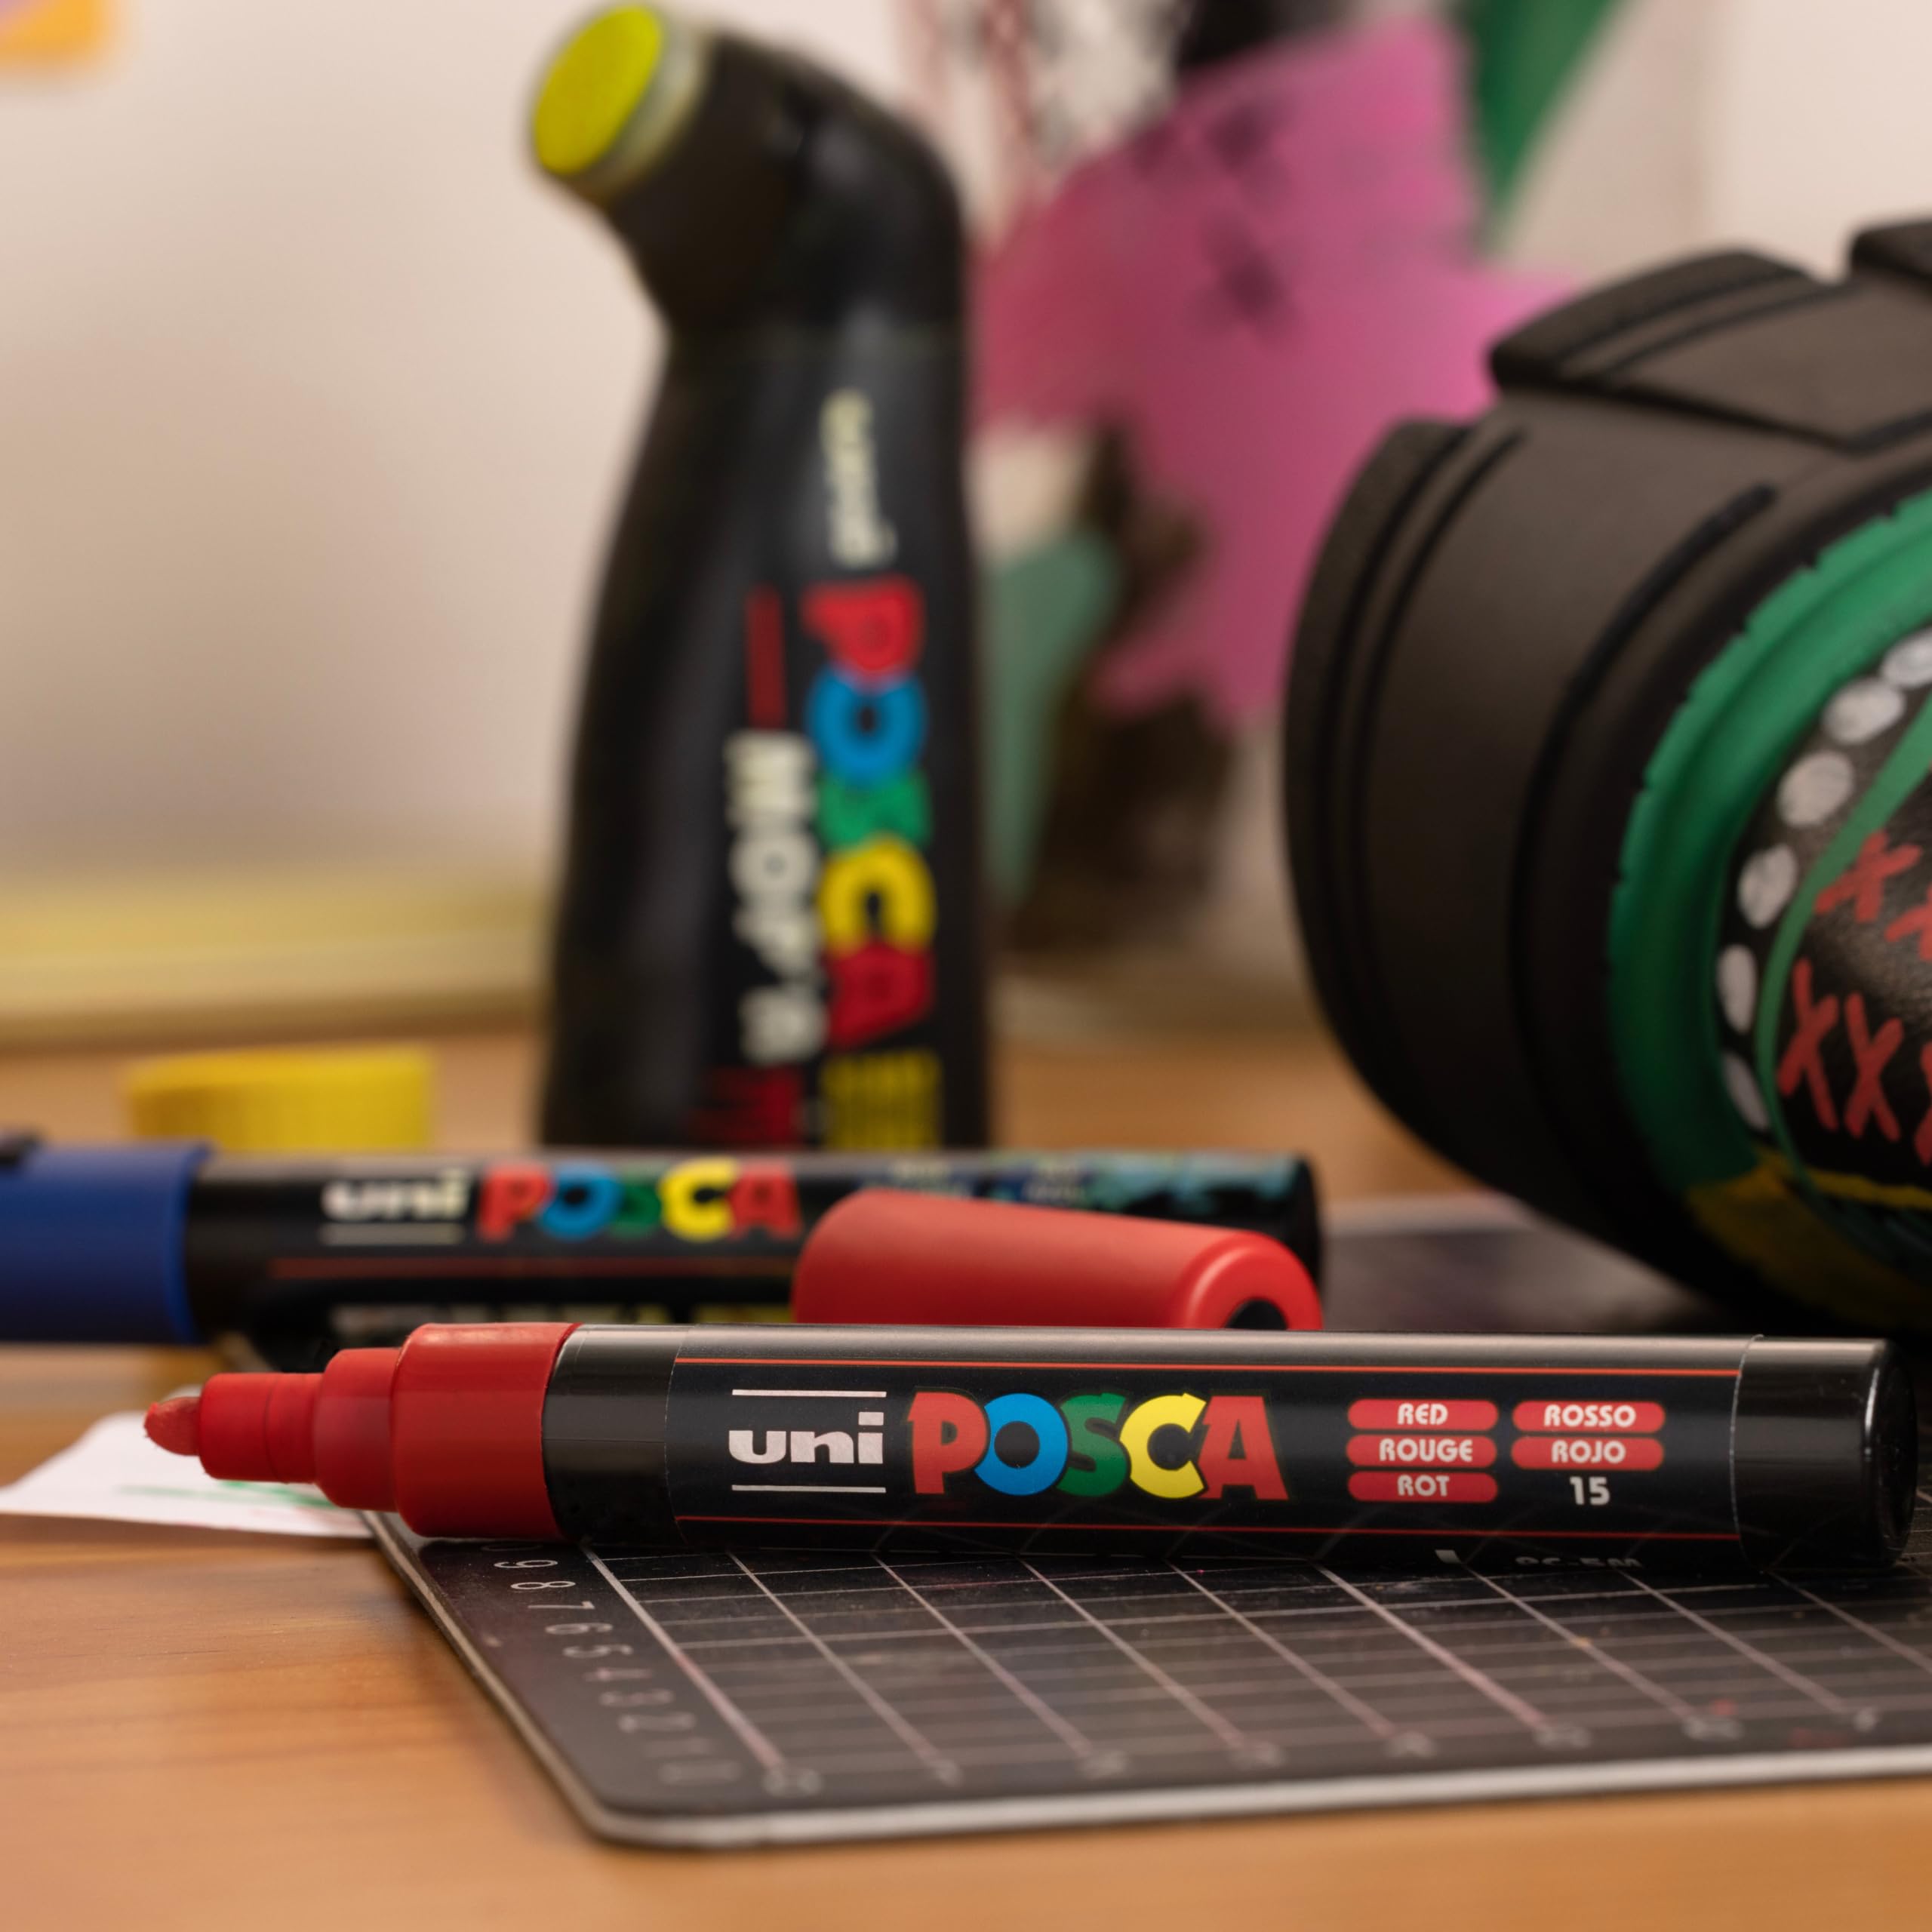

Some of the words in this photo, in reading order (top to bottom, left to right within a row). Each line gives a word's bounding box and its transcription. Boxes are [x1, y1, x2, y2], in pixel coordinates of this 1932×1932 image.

[802, 577, 934, 1049] POSCA
[324, 1171, 469, 1220] uni
[480, 1161, 801, 1240] POSCA
[1397, 1403, 1448, 1425] RED
[1543, 1404, 1636, 1428] ROSSO
[728, 1411, 884, 1465] uni
[908, 1392, 1289, 1500] POSCA
[1379, 1438, 1473, 1463] ROUGE
[1551, 1440, 1626, 1464] ROJO
[1397, 1475, 1450, 1497] ROT
[1570, 1476, 1611, 1506] 15
[494, 1559, 558, 1569] 9
[510, 1580, 576, 1590] 8
[528, 1600, 595, 1611] 7
[545, 1622, 614, 1635] 6
